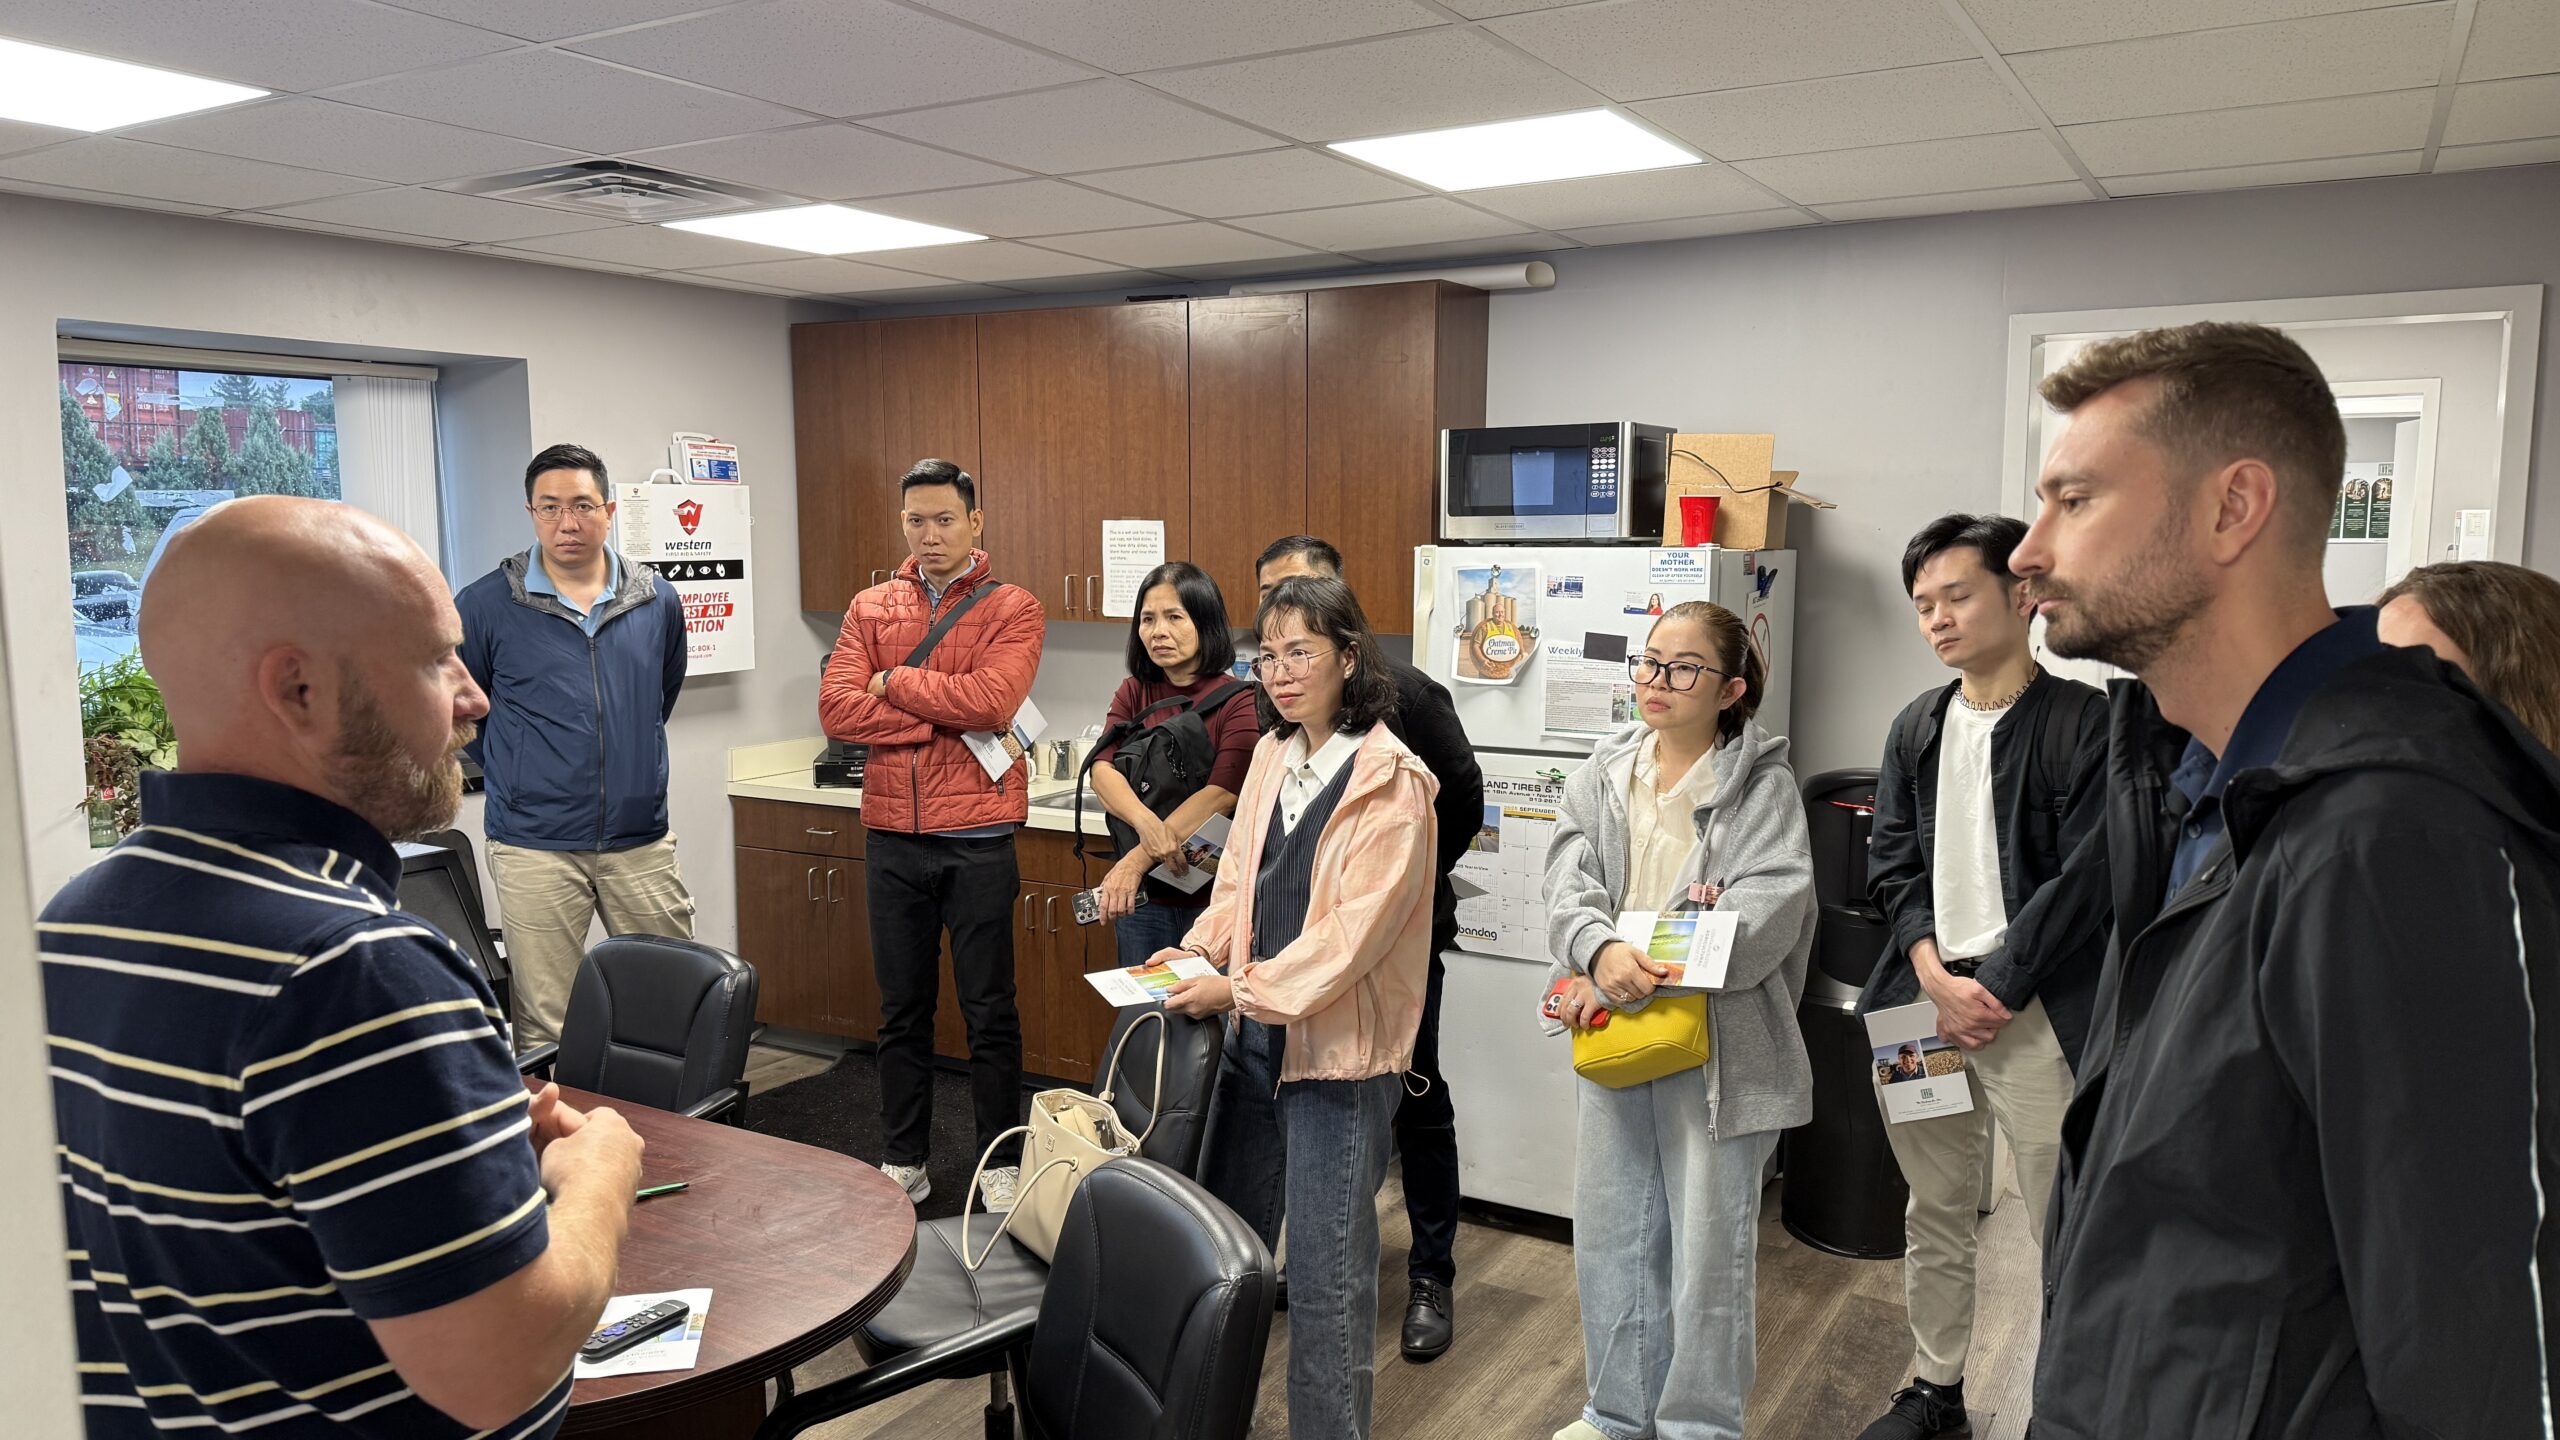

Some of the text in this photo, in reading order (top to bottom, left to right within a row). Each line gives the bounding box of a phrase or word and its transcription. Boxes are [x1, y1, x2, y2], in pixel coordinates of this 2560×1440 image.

[665, 540, 712, 550] western
[683, 605, 726, 618] RST AID
[685, 619, 725, 633] ATION
[1489, 639, 1515, 647] Oatmeal
[1486, 647, 1506, 655] Creme
[1548, 646, 1584, 657] Weekly
[1512, 782, 1541, 793] TIRES
[1545, 785, 1552, 793] &
[1519, 806, 1556, 814] SEPTEMBER
[1458, 924, 1497, 941] bandag
